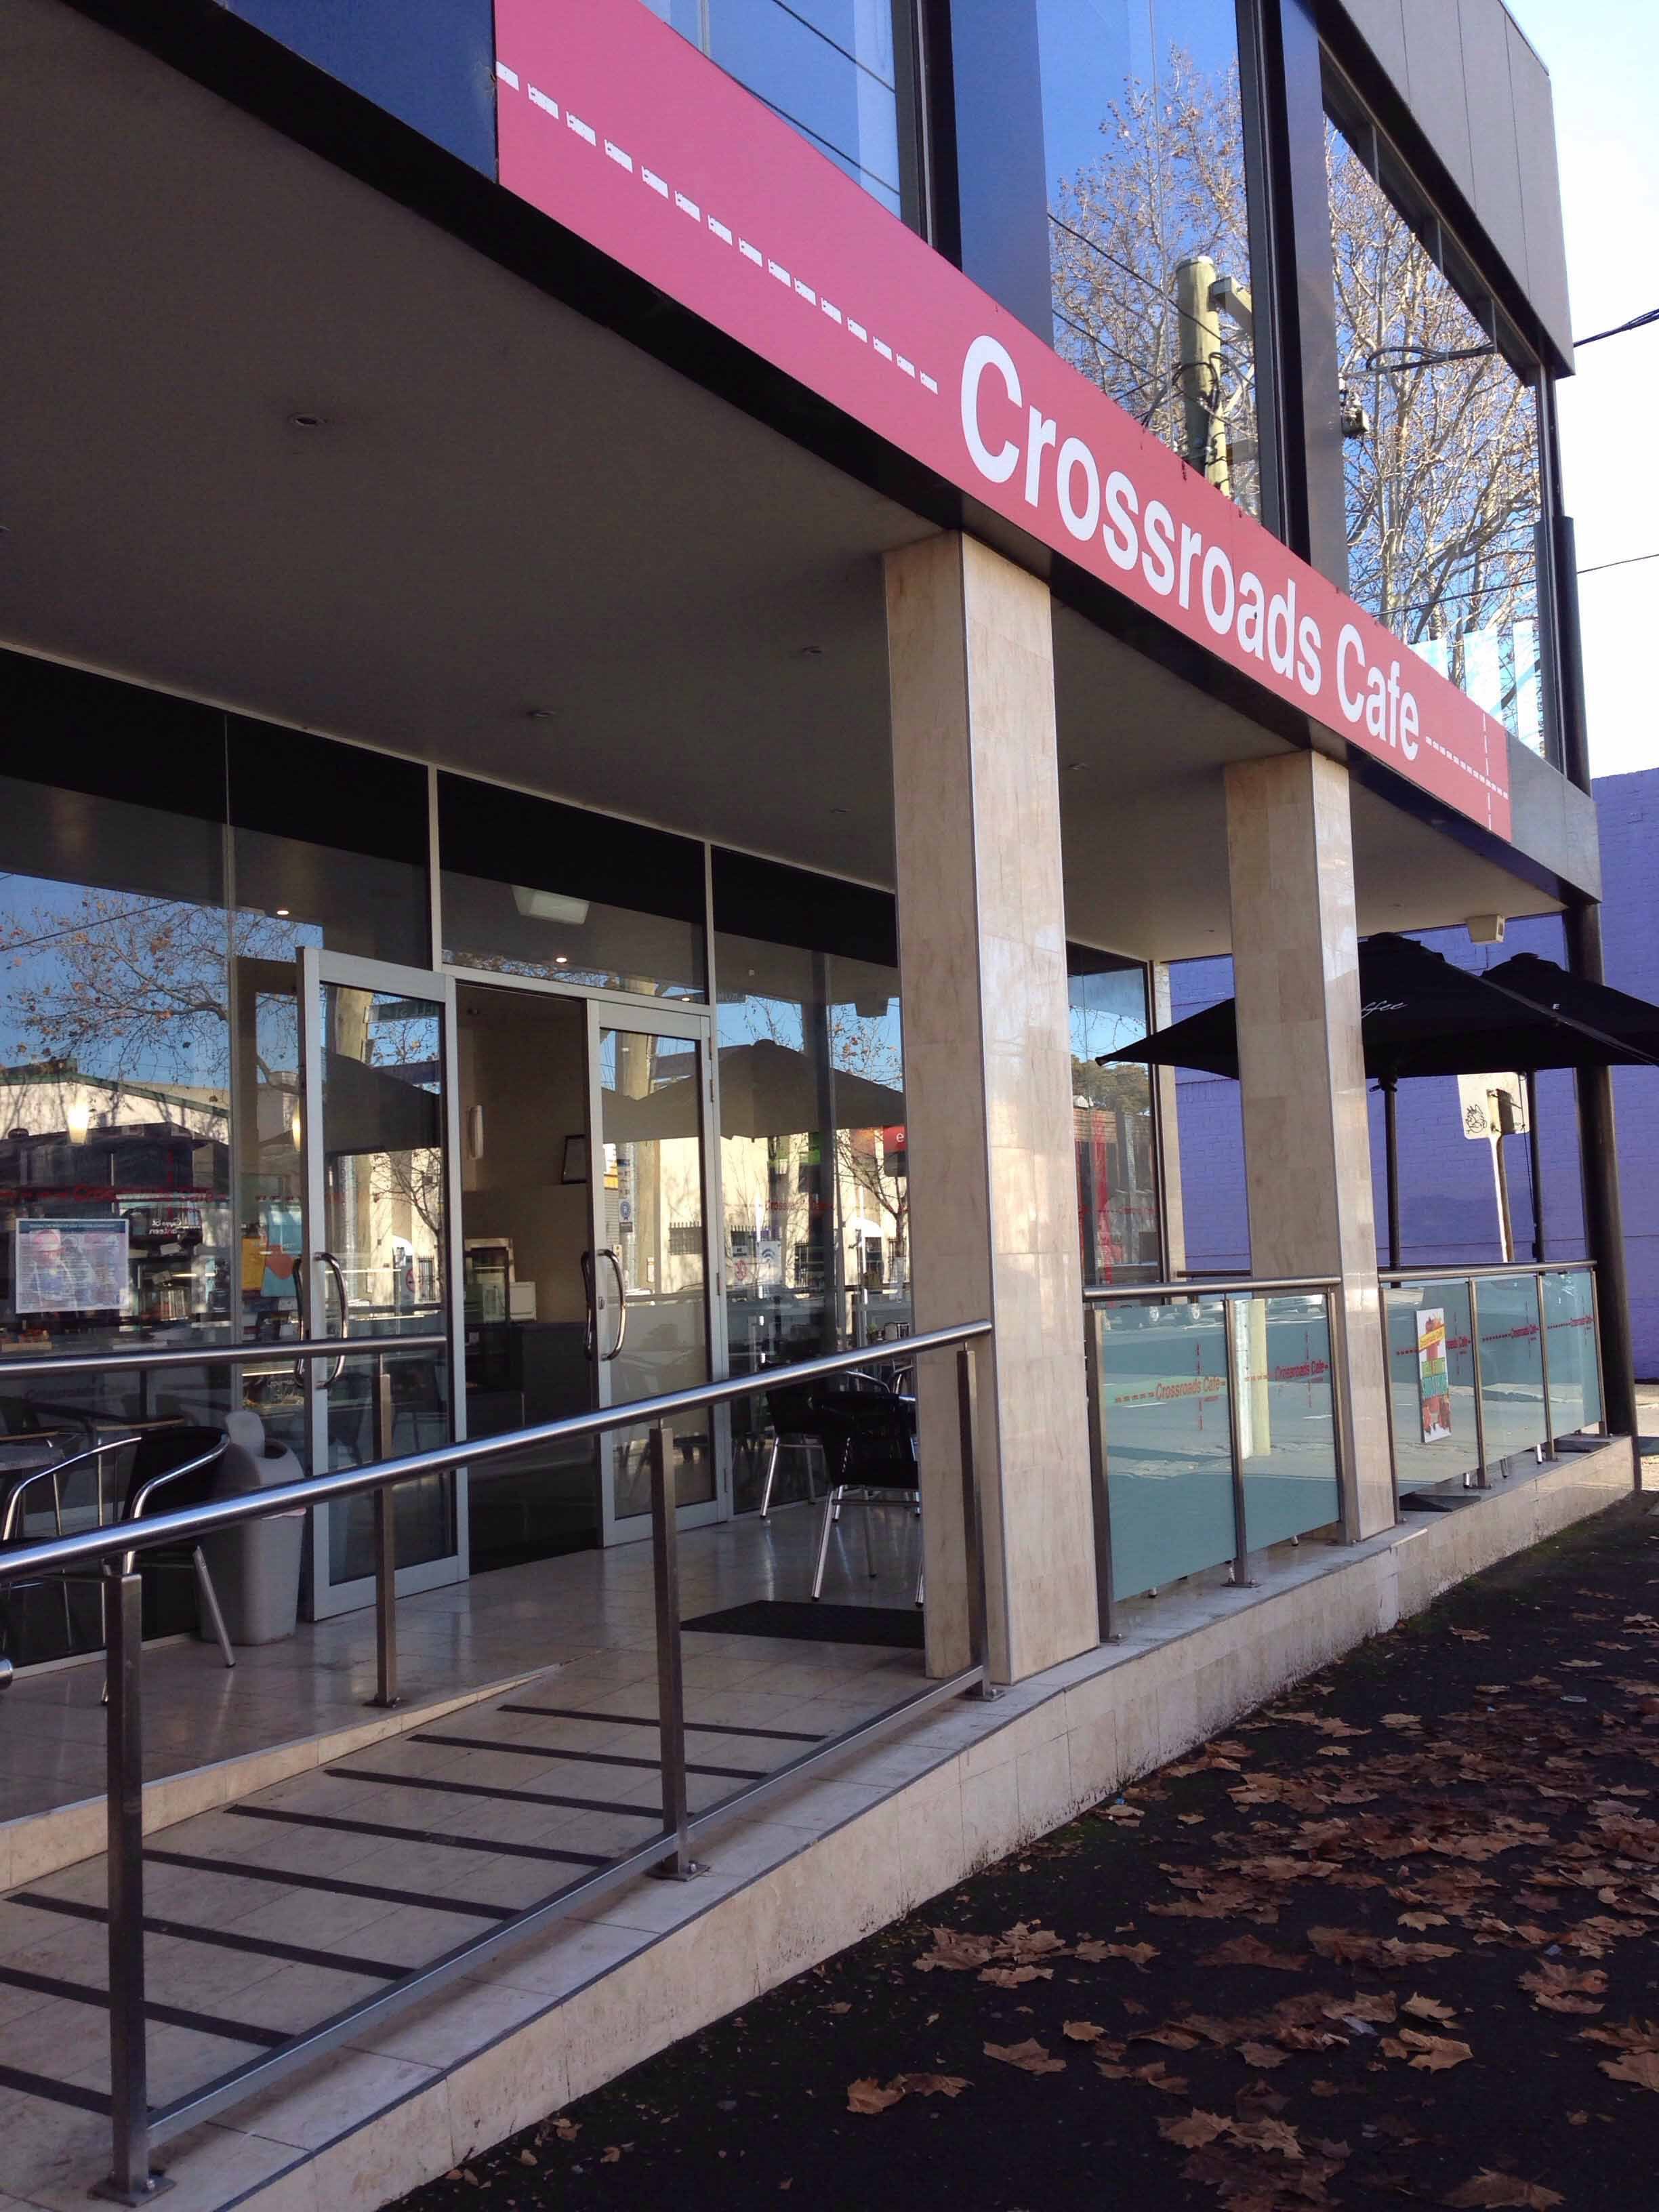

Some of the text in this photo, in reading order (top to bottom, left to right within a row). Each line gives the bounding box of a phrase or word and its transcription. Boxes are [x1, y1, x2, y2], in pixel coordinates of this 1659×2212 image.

[961, 335, 1418, 761] Crossroads Cafe
[1361, 1000, 1409, 1019] ffee
[1155, 1376, 1220, 1399] Crossroads Cafe
